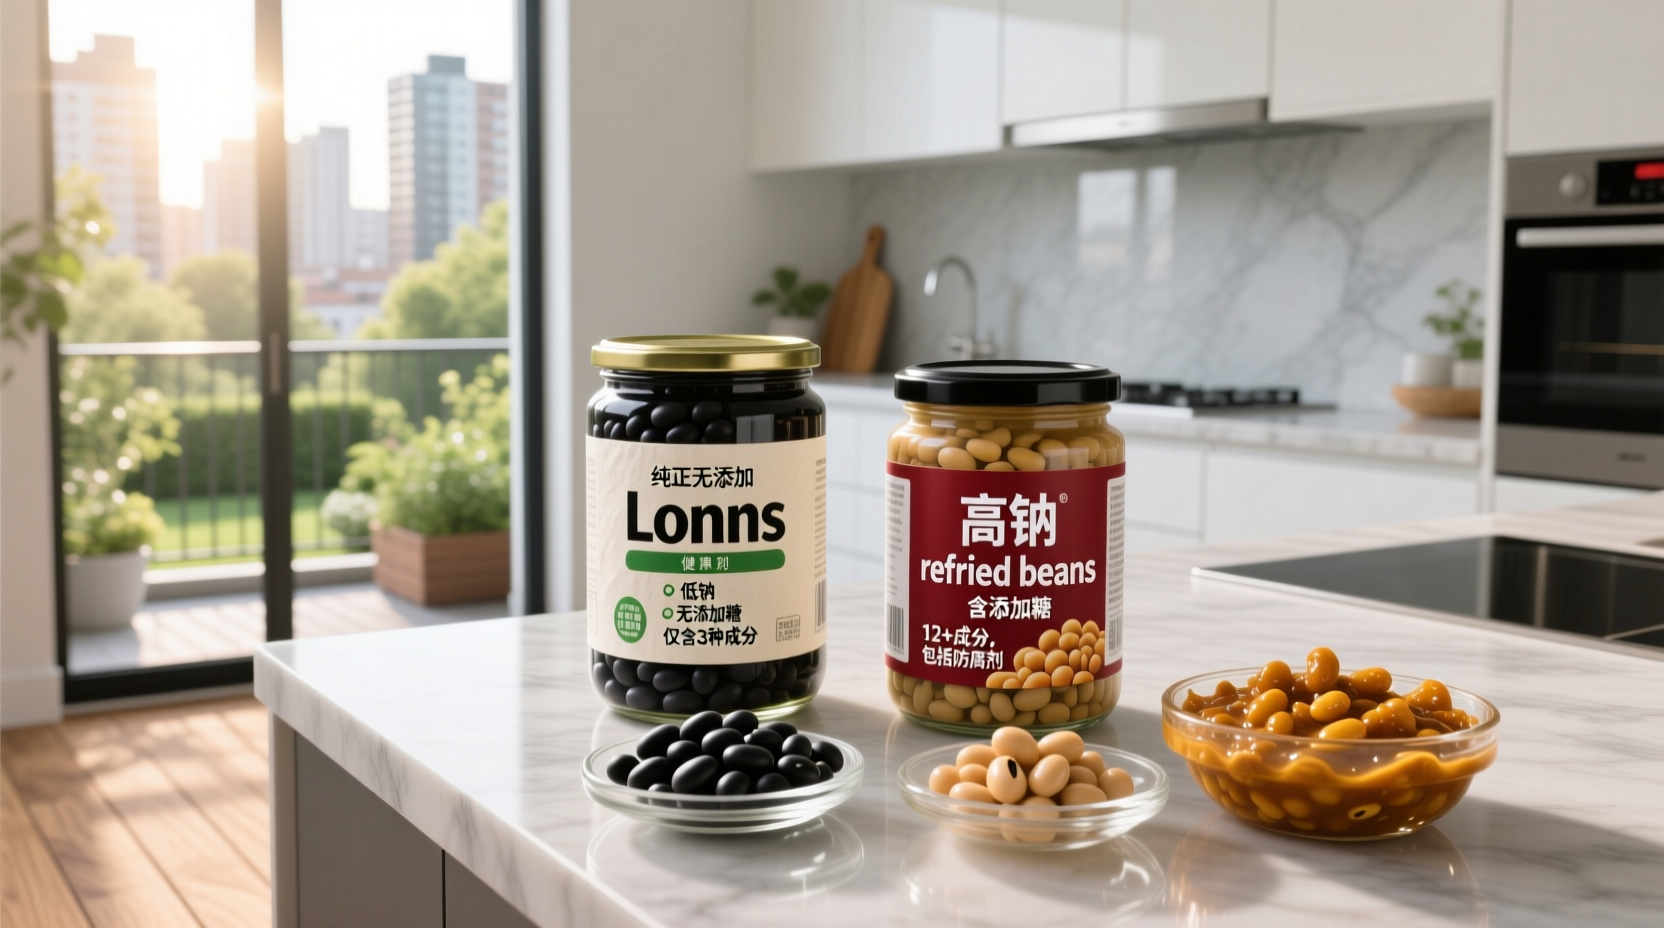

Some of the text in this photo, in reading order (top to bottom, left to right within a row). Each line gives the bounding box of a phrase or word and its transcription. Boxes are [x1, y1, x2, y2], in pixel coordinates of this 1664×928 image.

[651, 465, 753, 488] 纯正无添加
[627, 491, 786, 544] Lonns
[961, 492, 1057, 547] 高钠
[921, 553, 1011, 587] refried
[1019, 554, 1096, 587] beans
[680, 581, 715, 601] 低钠
[676, 603, 742, 623] 无添加糖
[967, 595, 1052, 620] 含添加糖
[663, 625, 758, 646] 仅含3种成分
